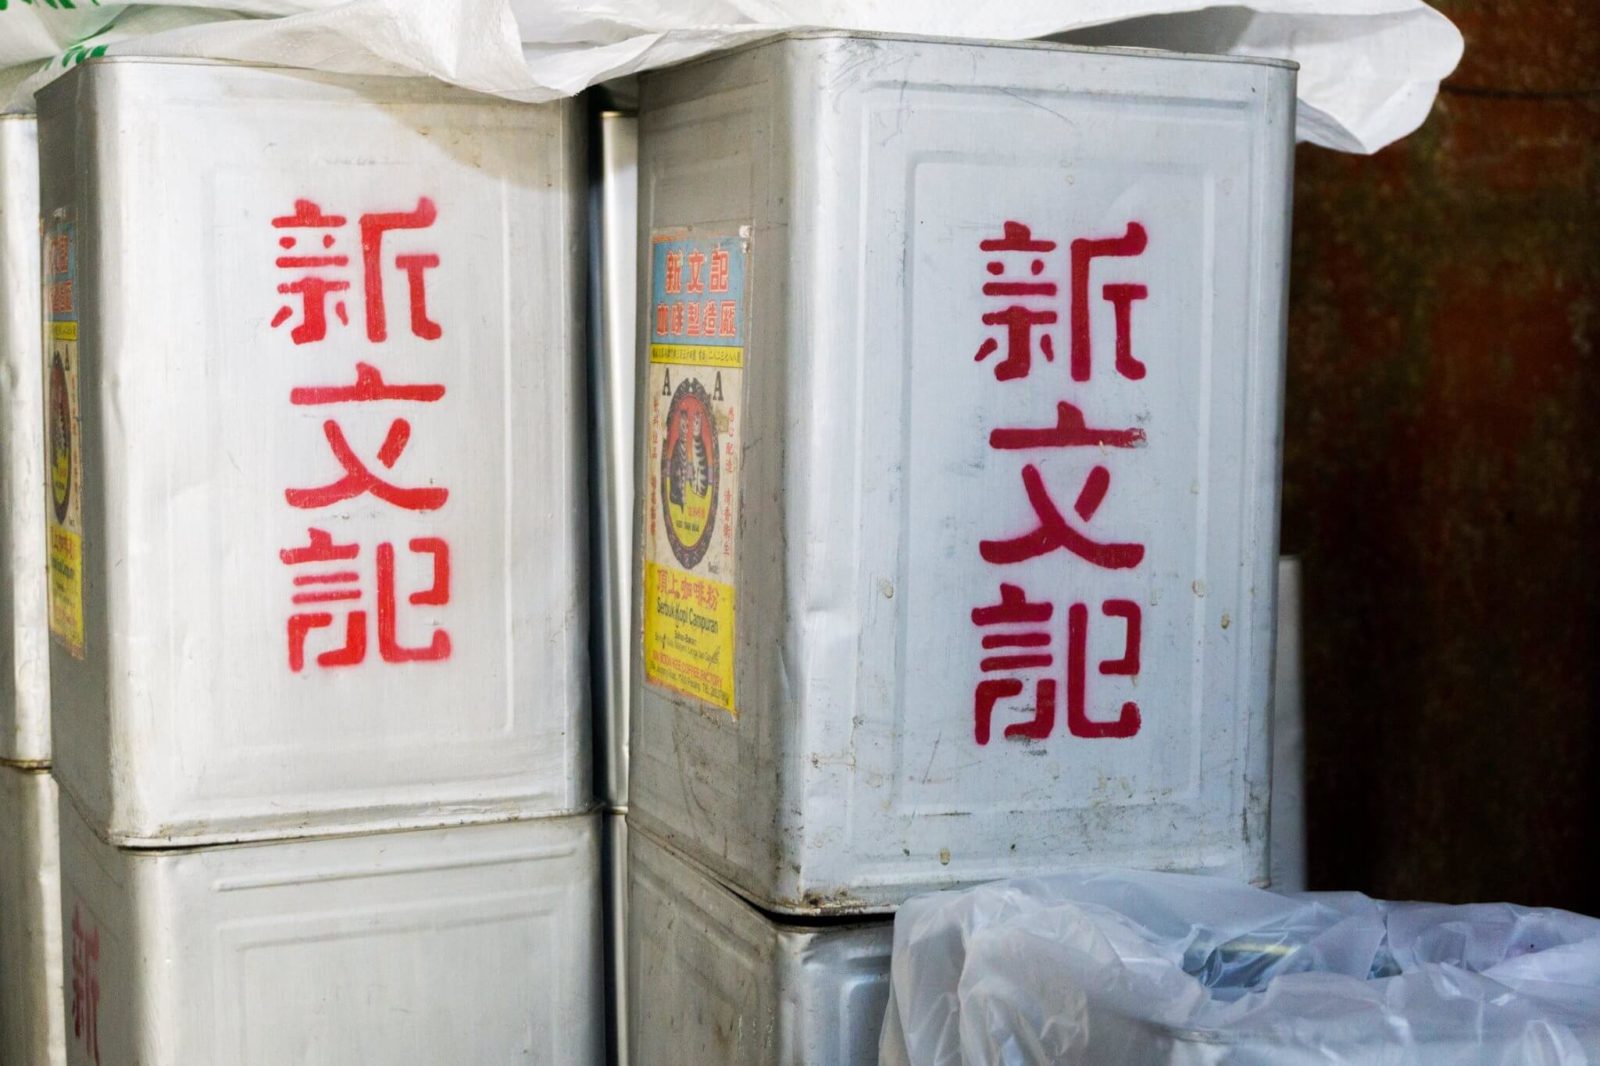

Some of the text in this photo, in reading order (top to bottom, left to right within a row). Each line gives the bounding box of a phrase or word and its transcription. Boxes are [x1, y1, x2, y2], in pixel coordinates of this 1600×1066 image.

[665, 248, 730, 294] 新文記
[713, 370, 724, 401] A
[270, 196, 452, 674] 新文記
[971, 219, 1149, 746] 新文記
